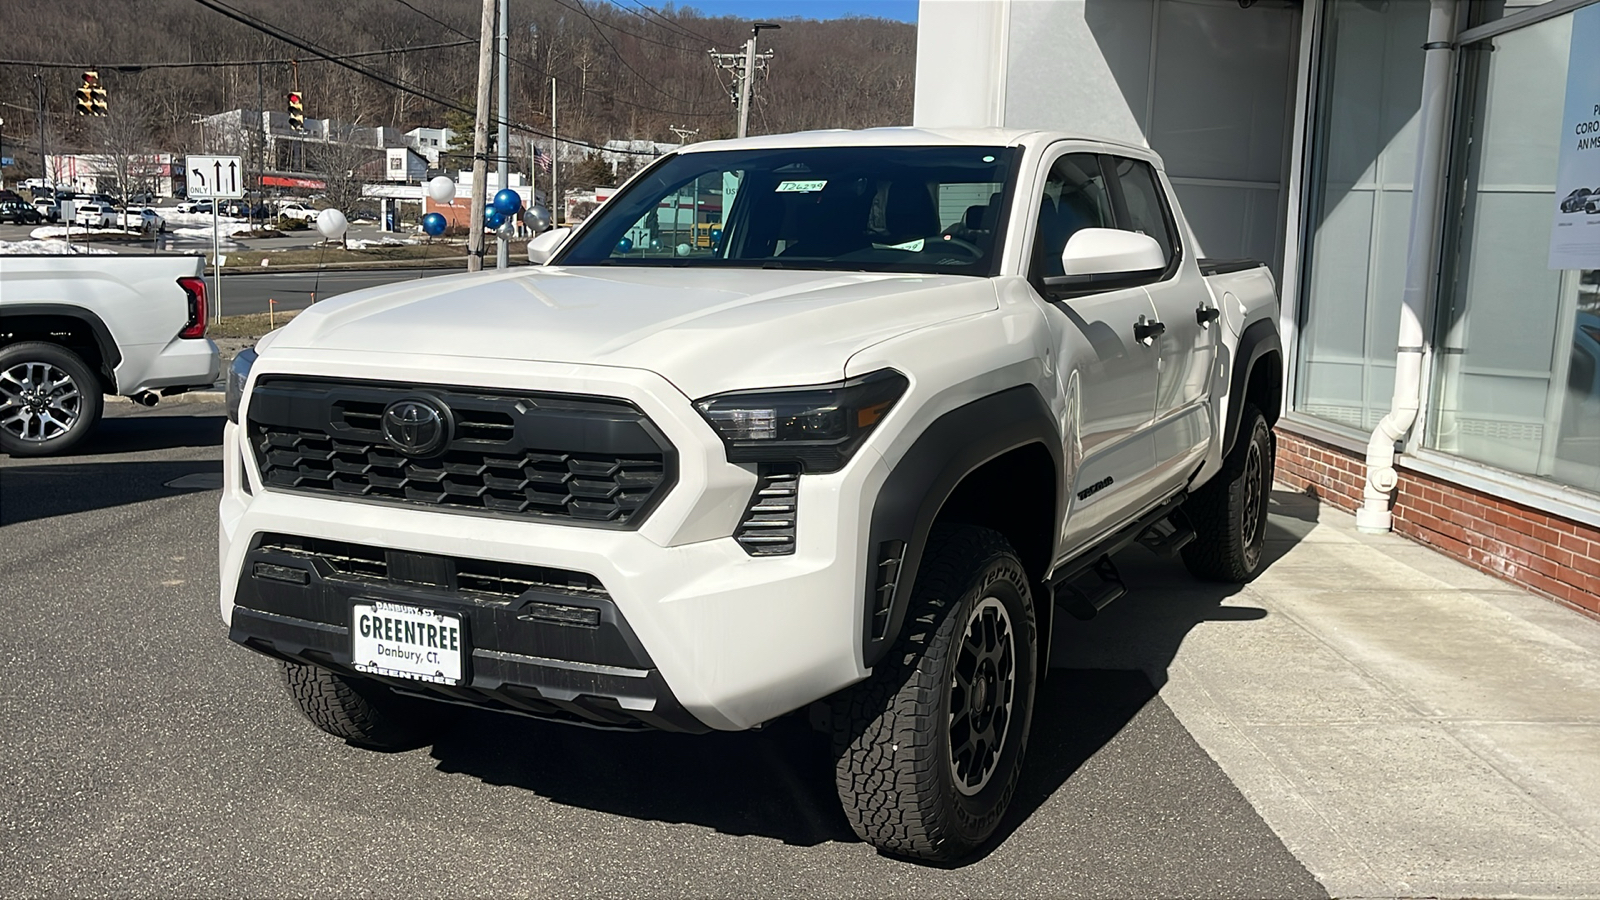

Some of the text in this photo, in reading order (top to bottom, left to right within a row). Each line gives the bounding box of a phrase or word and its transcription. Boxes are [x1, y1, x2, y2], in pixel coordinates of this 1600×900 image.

[1577, 138, 1589, 151] AN
[359, 614, 459, 651] GREENTREE
[377, 644, 440, 664] Danbury, CT.
